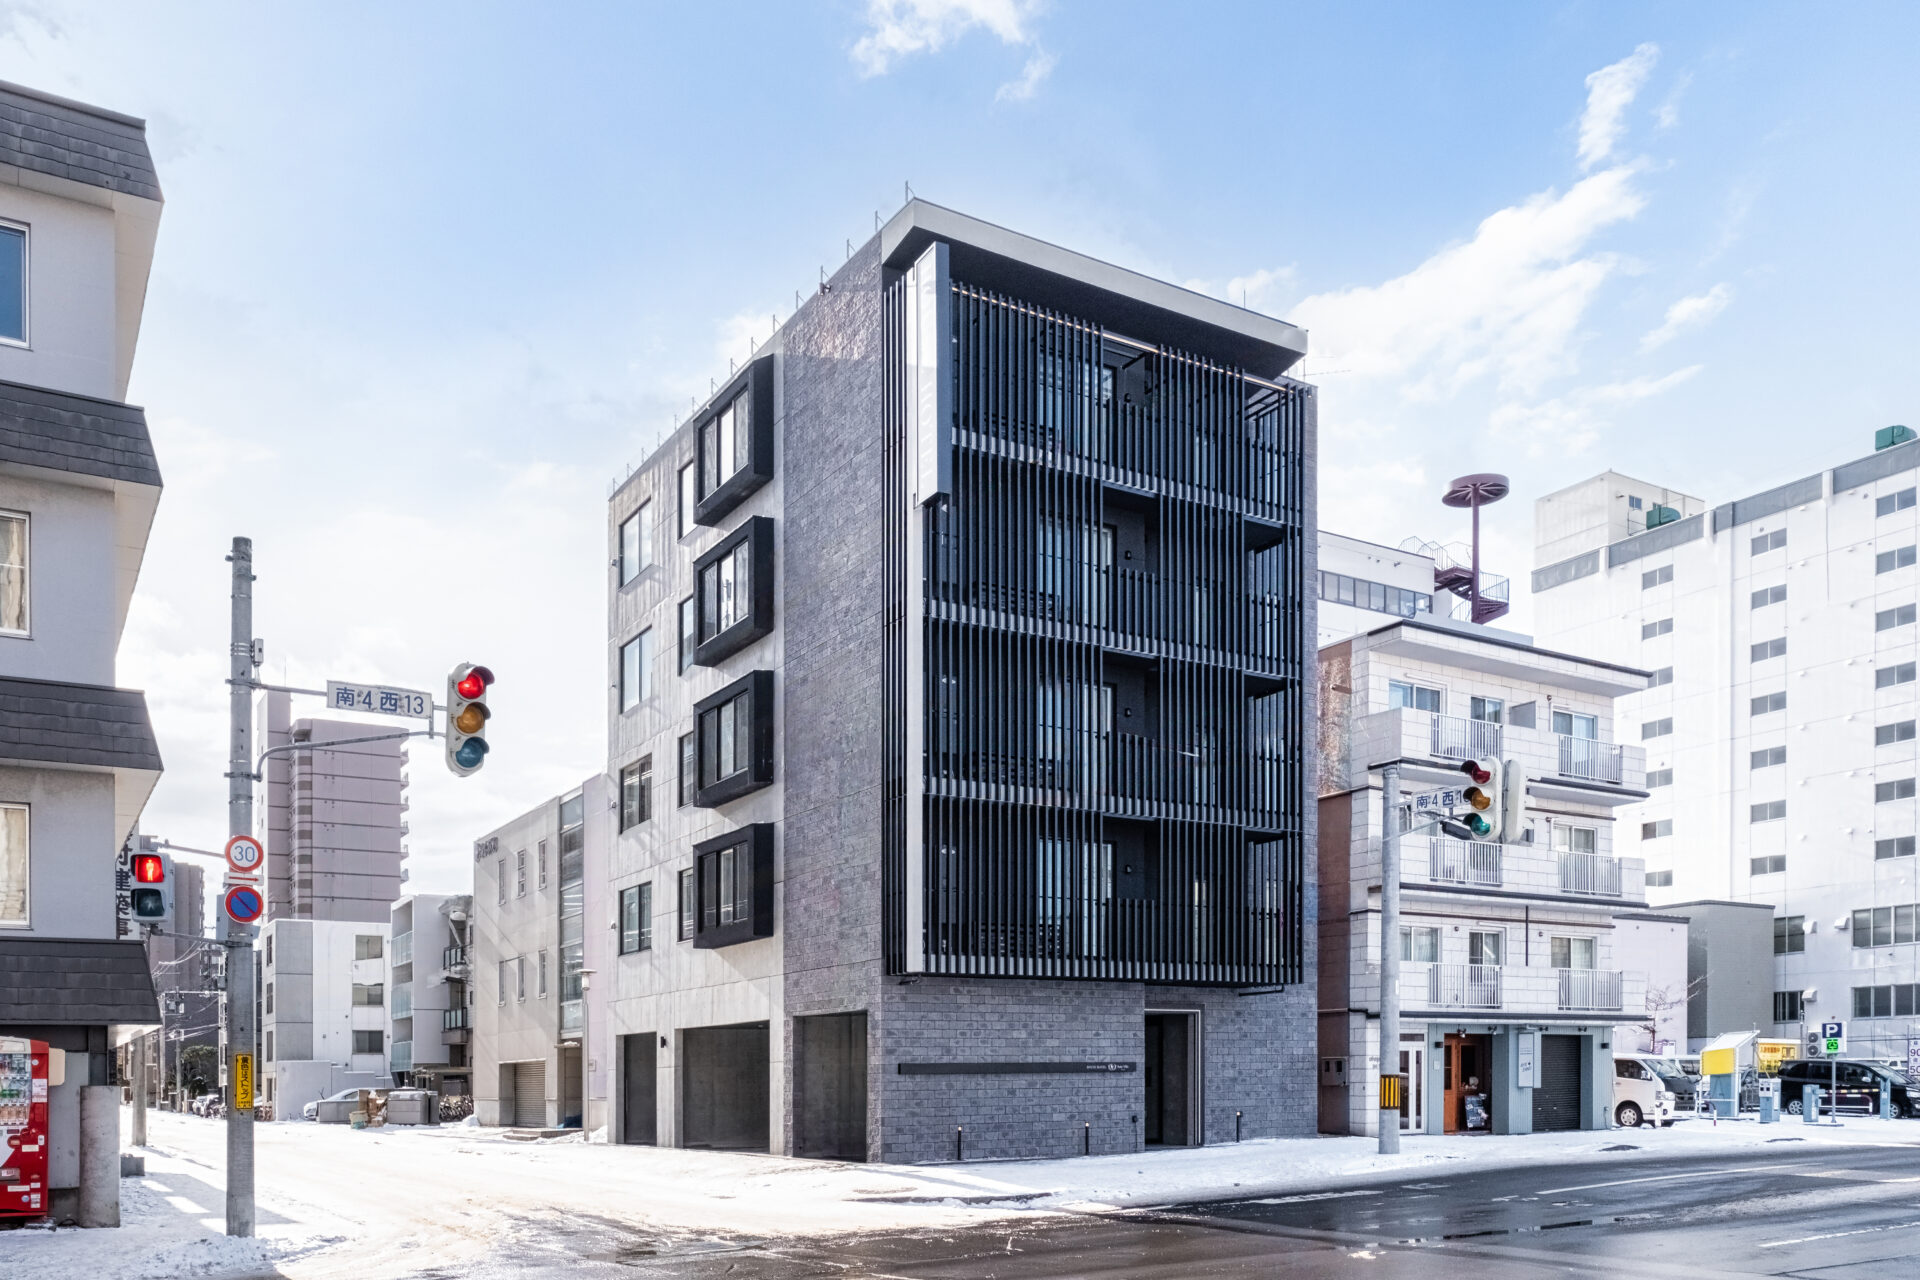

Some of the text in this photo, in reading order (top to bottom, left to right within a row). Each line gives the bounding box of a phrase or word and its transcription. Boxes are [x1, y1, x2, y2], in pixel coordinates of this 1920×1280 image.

[336, 687, 424, 715] 南4西13
[1416, 789, 1469, 809] 南4西1
[234, 845, 255, 862] 30
[1825, 1023, 1839, 1038] P
